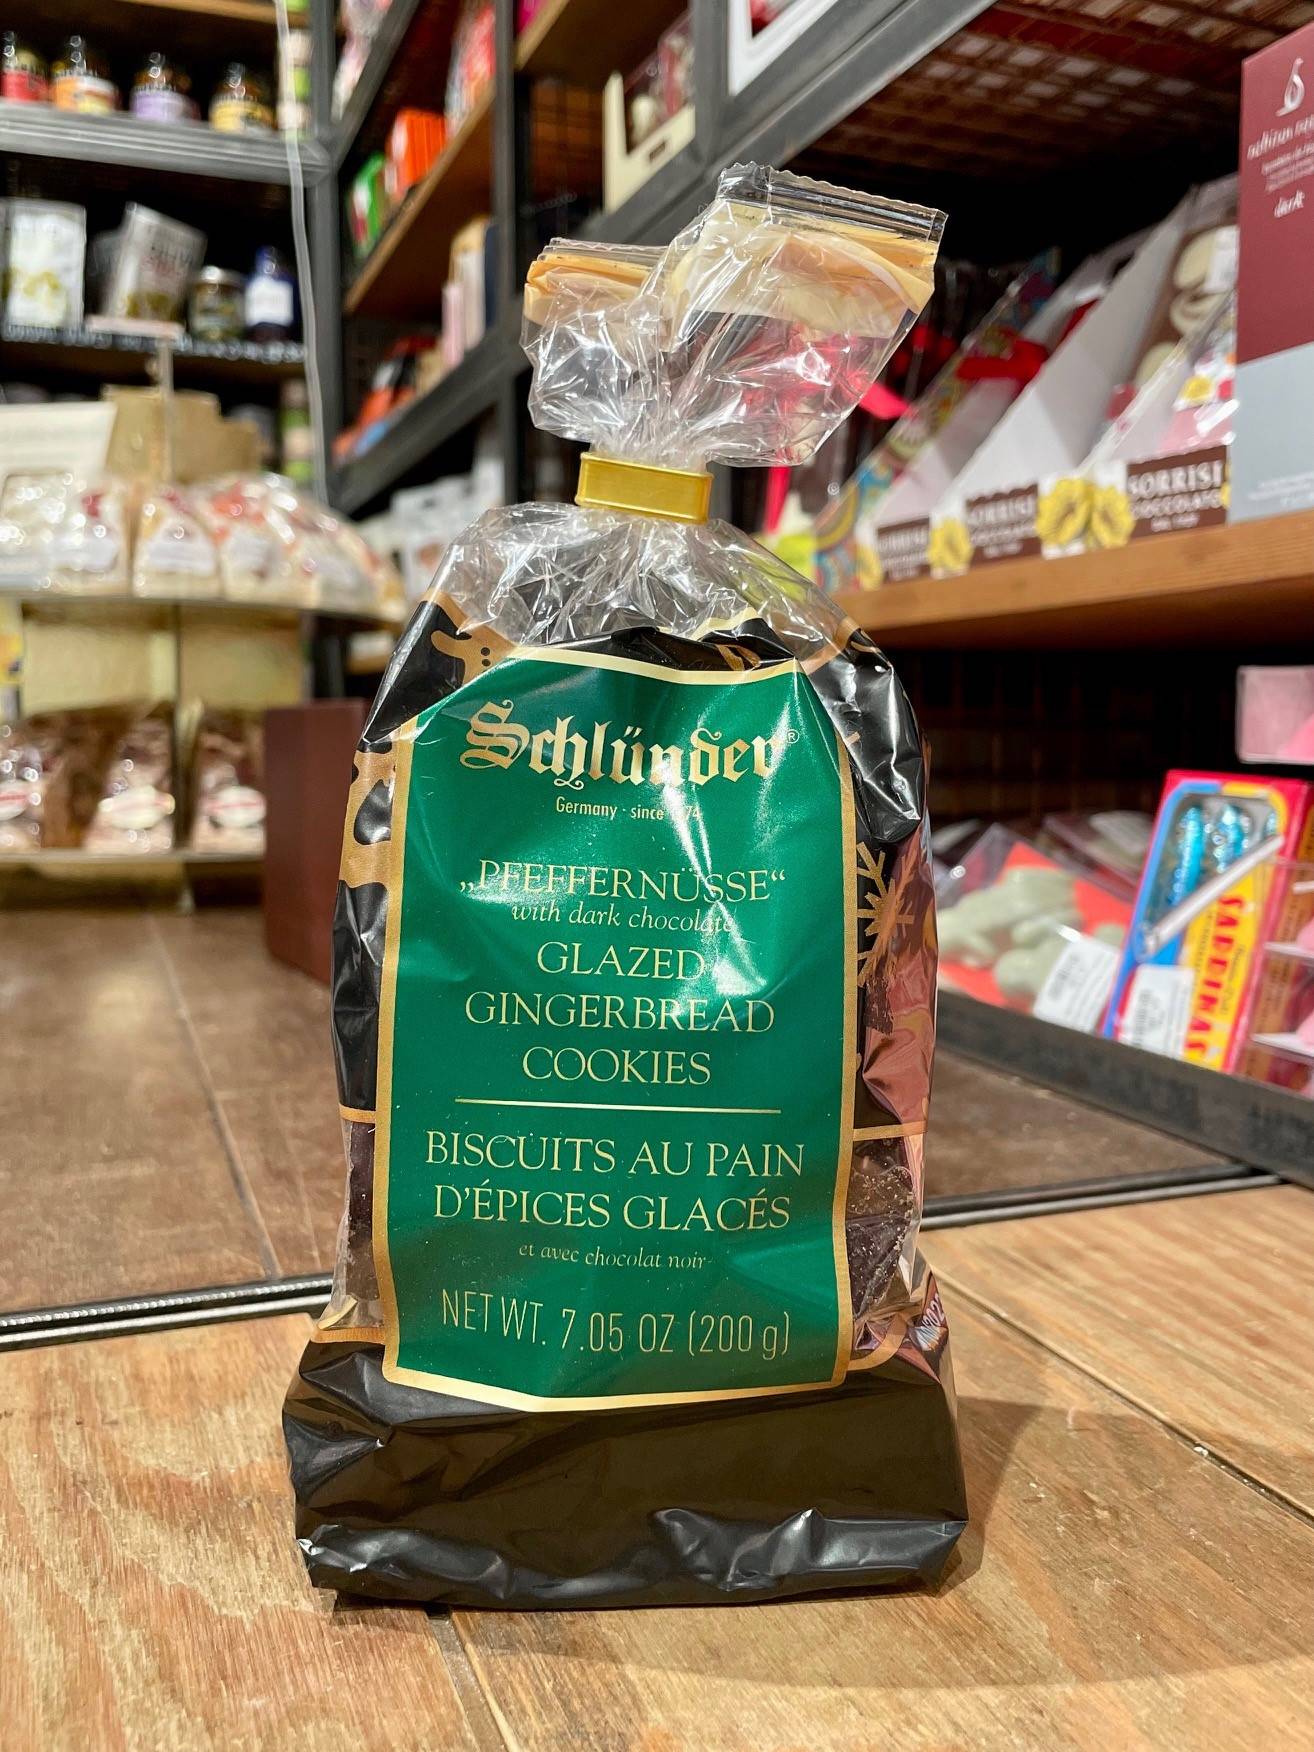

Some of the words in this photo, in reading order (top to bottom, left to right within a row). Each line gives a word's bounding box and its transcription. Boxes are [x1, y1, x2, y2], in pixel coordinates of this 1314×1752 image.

[555, 795, 619, 821] Germany
[630, 803, 665, 821] since
[511, 899, 561, 922] with
[568, 900, 622, 928] dark
[628, 904, 736, 933] chocolate
[536, 941, 706, 981] GLAZED
[464, 990, 775, 1033] GINGERBREAD
[522, 1046, 712, 1086] COOKIES
[425, 1130, 617, 1174] BISCUITS
[628, 1140, 692, 1176] AU
[706, 1142, 805, 1178] PAIN
[622, 1189, 791, 1233] GLACÉS
[519, 1244, 536, 1257] et
[541, 1246, 580, 1263] avec
[585, 1245, 663, 1268] chocolat
[668, 1251, 707, 1270] noir
[441, 1288, 494, 1332] NET
[500, 1298, 547, 1347] WT.
[561, 1308, 625, 1354] 7.05
[639, 1312, 677, 1354] OZ
[688, 1310, 754, 1358] (200
[761, 1310, 791, 1361] g)
